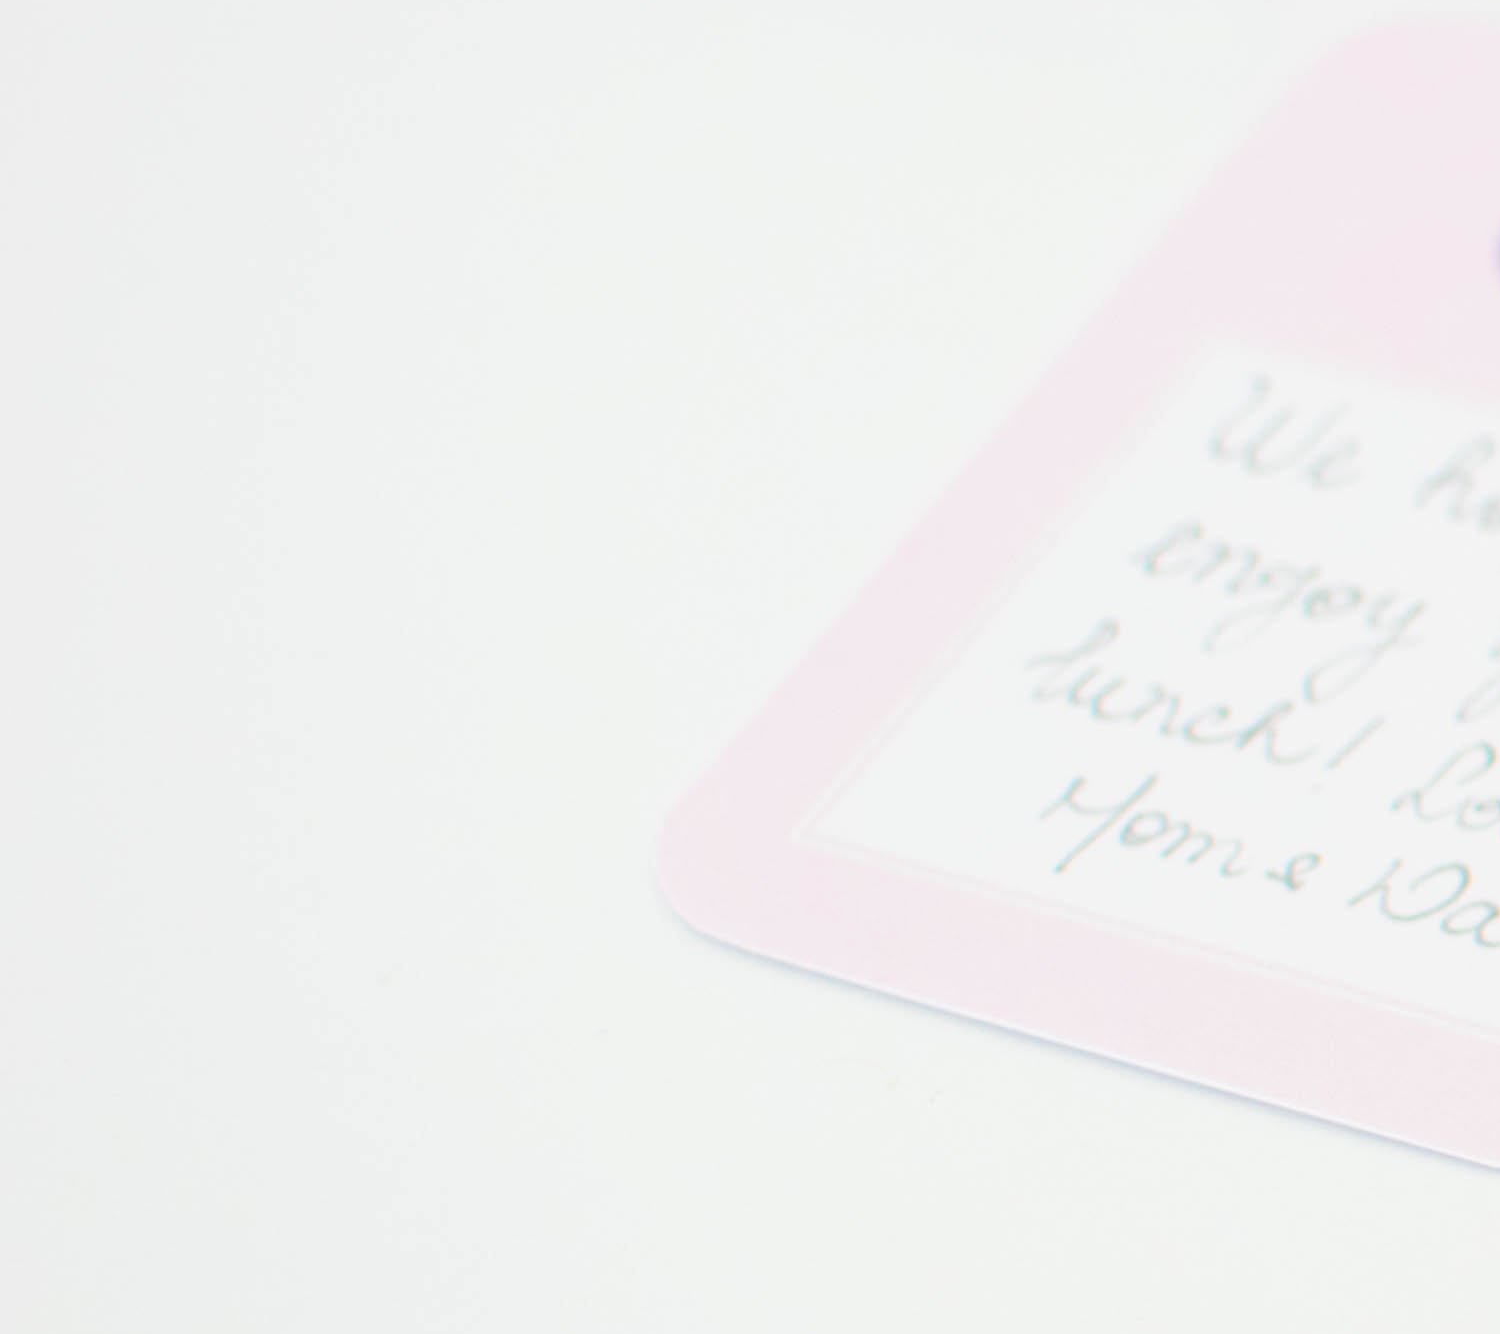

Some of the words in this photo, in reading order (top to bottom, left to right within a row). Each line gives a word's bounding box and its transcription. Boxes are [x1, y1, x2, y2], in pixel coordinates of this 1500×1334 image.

[1207, 371, 1368, 491] We
[1130, 517, 1425, 705] enjoy
[1038, 771, 1246, 878] Mom
